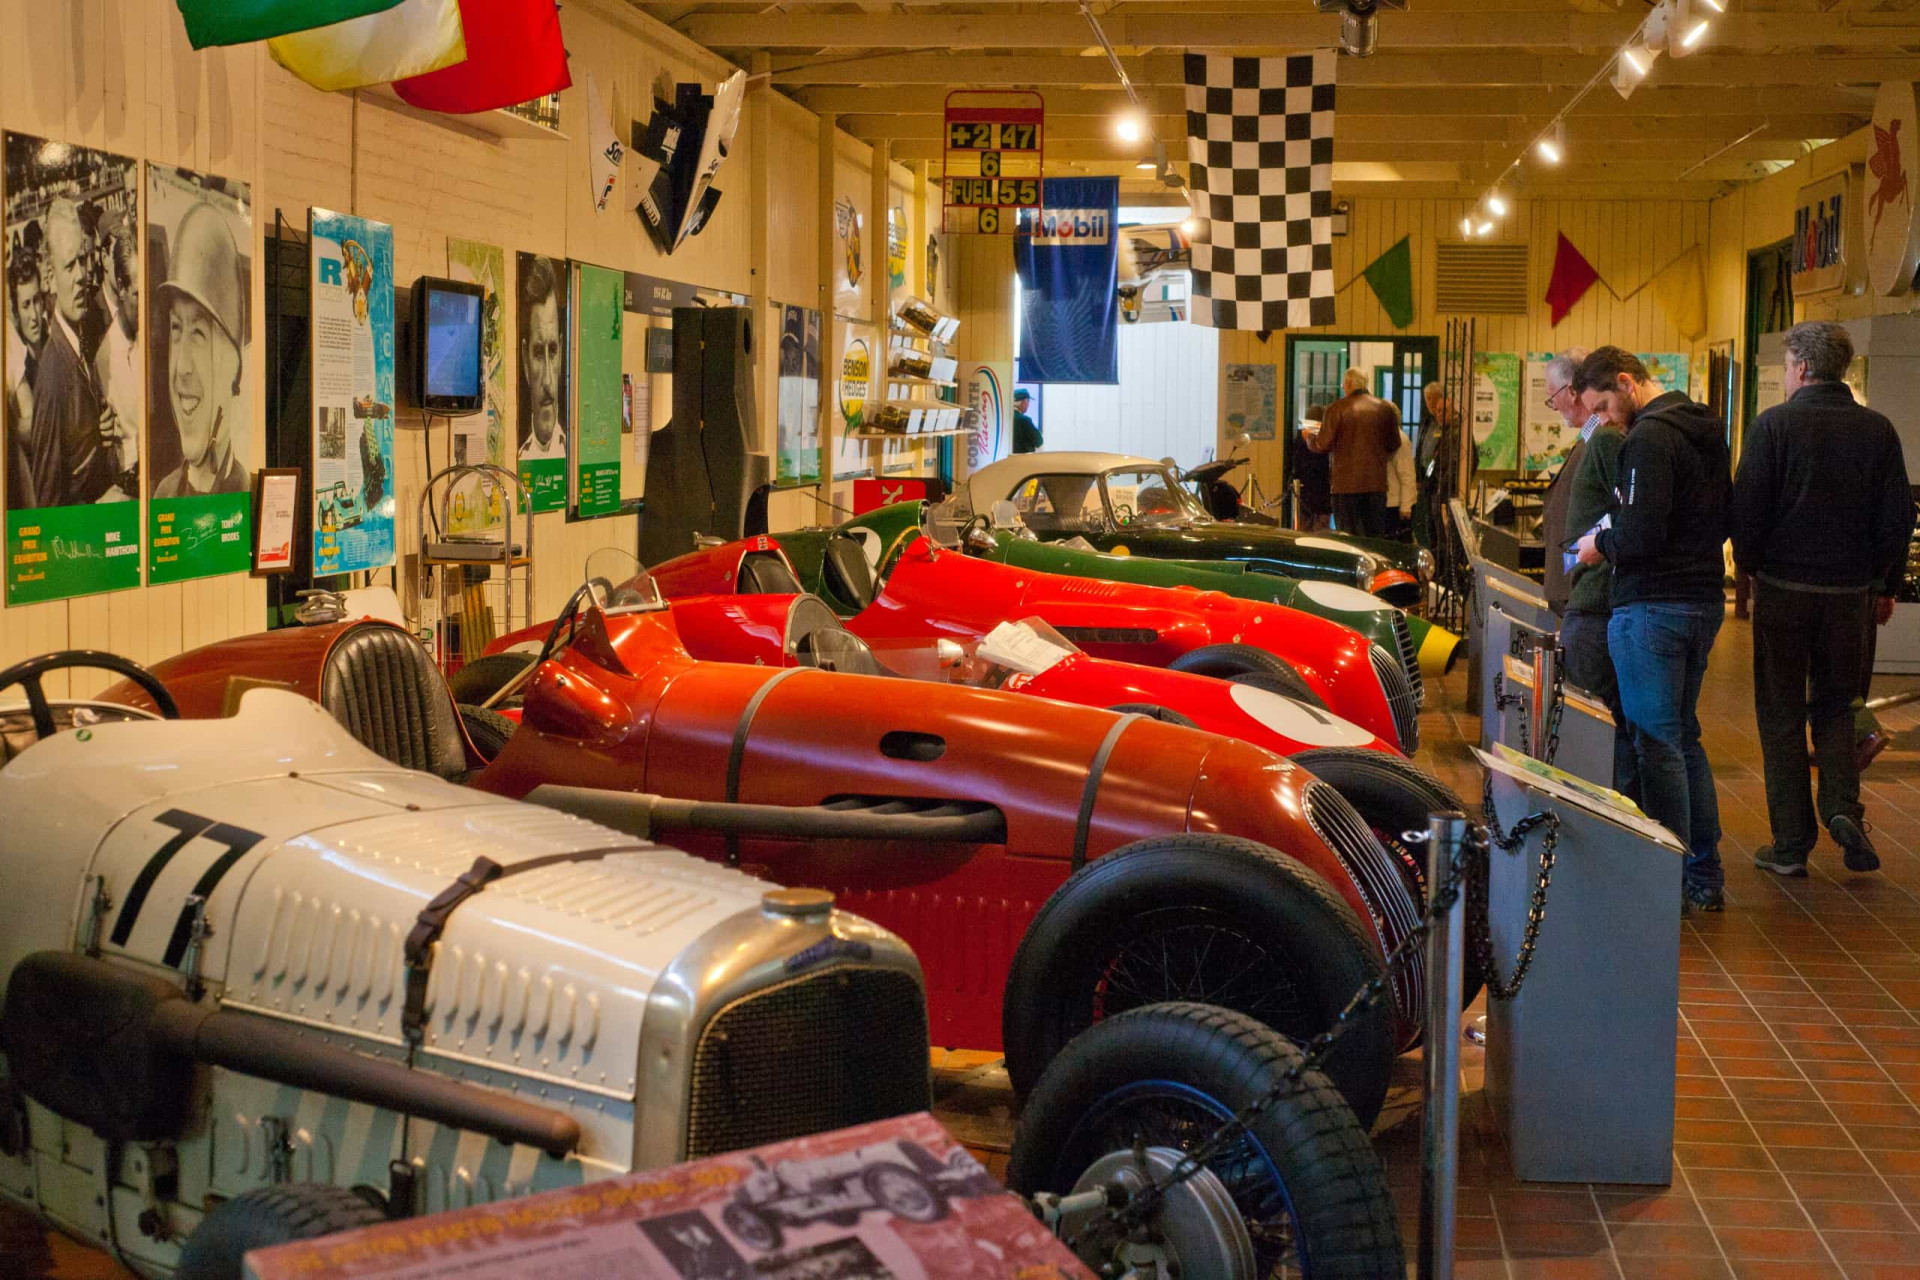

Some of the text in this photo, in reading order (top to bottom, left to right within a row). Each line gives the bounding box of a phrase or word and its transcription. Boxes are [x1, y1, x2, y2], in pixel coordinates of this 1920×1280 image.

[1001, 125, 1035, 149] 47
[981, 152, 999, 177] 6
[953, 181, 1038, 204] FUEL 55
[980, 208, 998, 233] 6
[1035, 215, 1104, 238] Mobil
[1793, 194, 1842, 275] Mobil
[319, 257, 342, 287] R
[843, 358, 868, 377] BENSON
[105, 532, 121, 543] MIKE
[105, 544, 138, 558] HAWTHORN
[109, 808, 268, 970] 77
